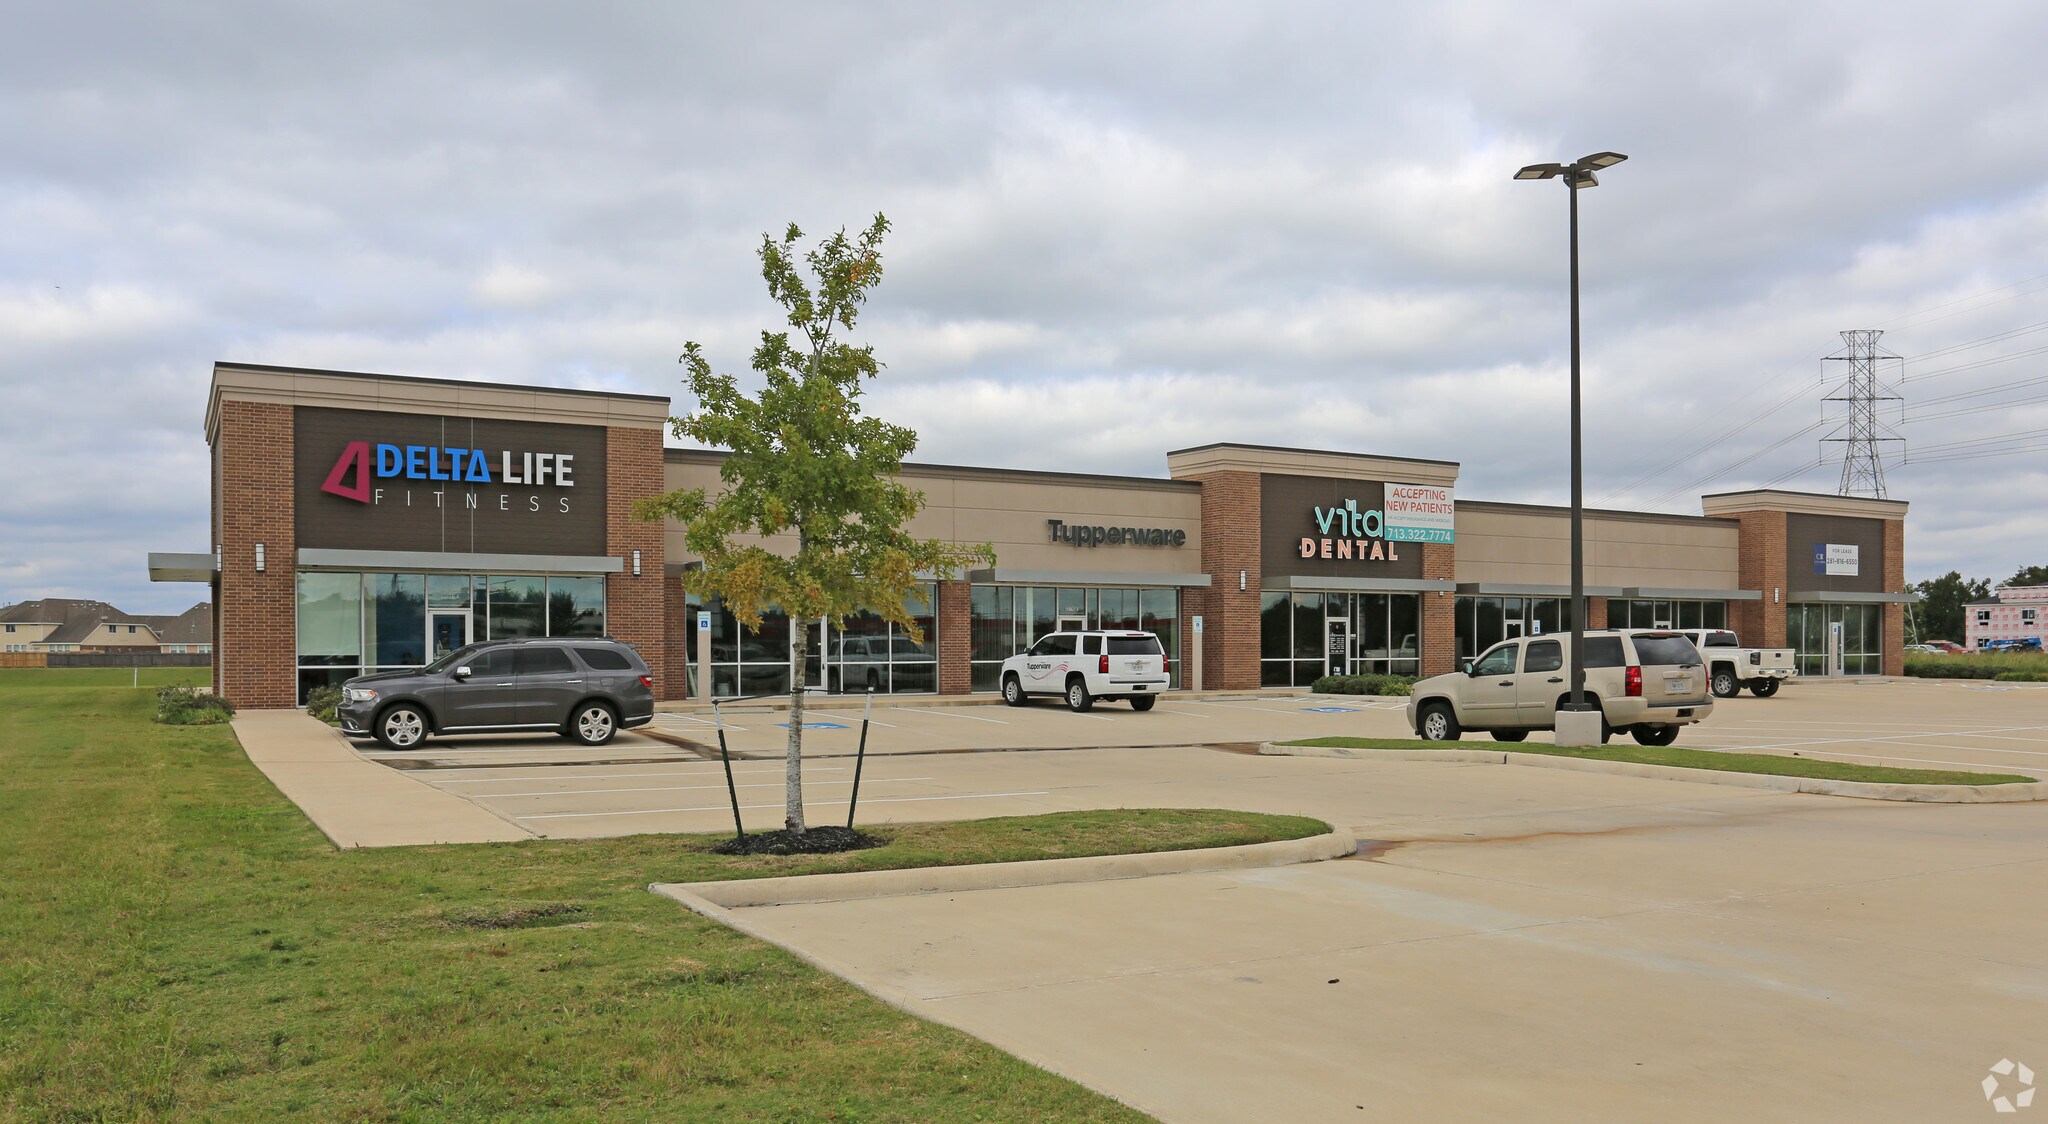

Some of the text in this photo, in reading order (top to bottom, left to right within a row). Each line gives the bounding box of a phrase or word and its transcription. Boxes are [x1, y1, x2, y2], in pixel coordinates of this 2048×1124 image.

[376, 443, 574, 487] DELTA LIFE
[375, 488, 569, 513] FITNESS
[1392, 487, 1446, 501] ACCEPTING
[1314, 498, 1383, 538] vita
[1386, 500, 1453, 515] NEW PATIENTS
[1047, 519, 1187, 548] Tupperware
[1388, 527, 1451, 541] 713.322.7774
[1301, 537, 1399, 561] DENTAL
[1027, 662, 1051, 671] Tupperware
